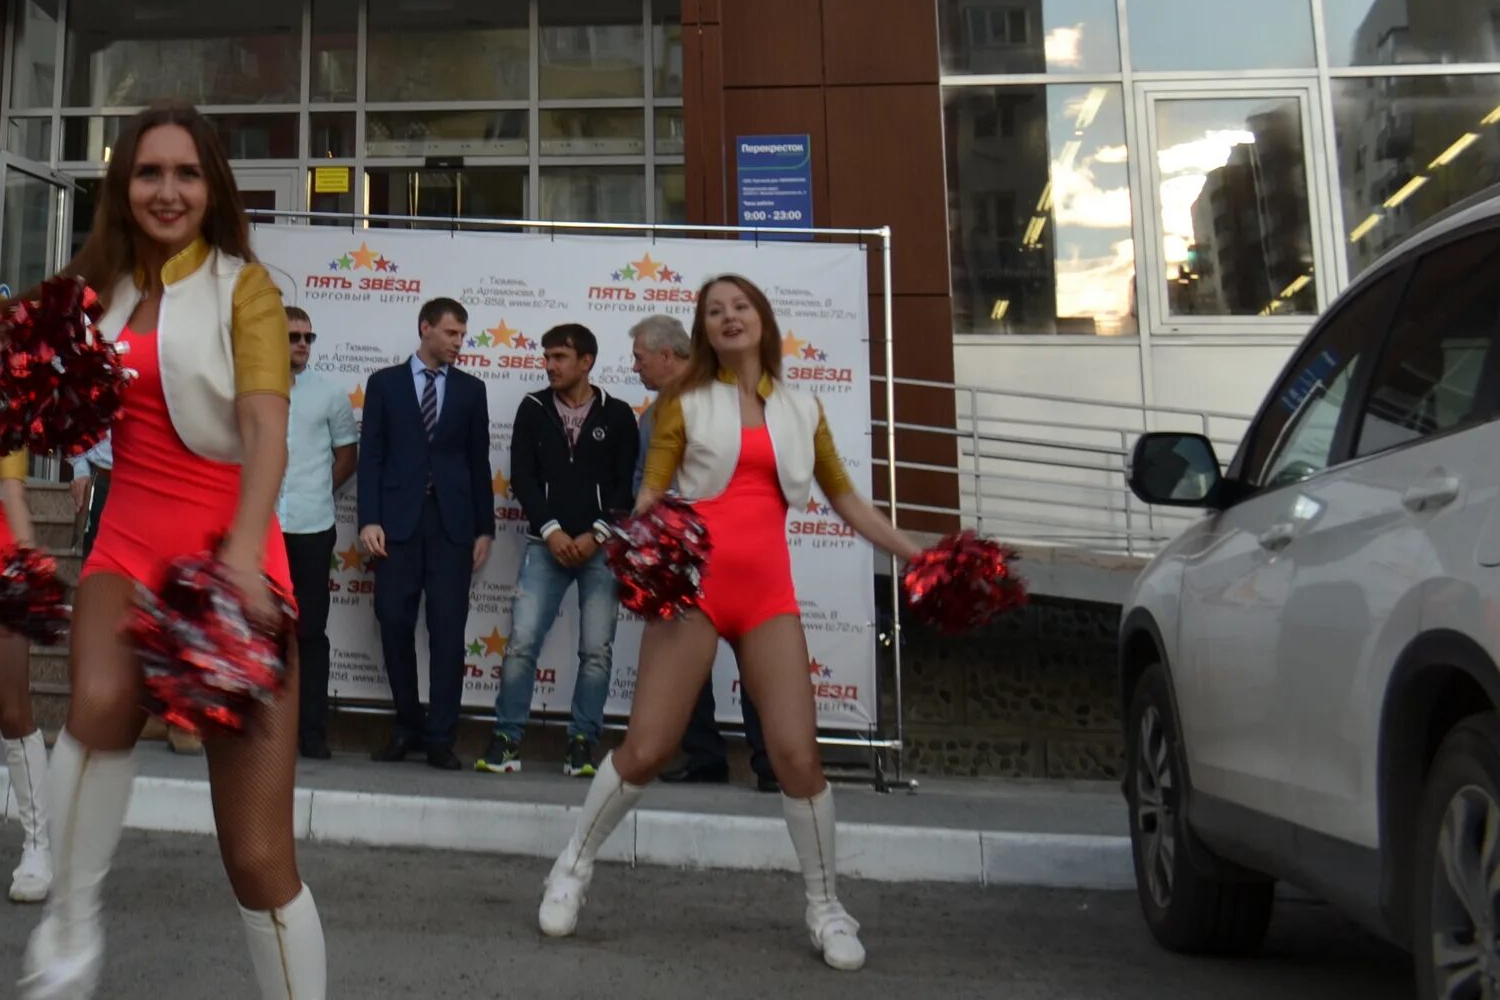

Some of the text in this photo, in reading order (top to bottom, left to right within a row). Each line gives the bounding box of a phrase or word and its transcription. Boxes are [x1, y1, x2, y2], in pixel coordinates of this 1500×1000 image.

[741, 143, 804, 154] Перекресток
[743, 210, 766, 221] 9:00
[773, 210, 802, 221] 23:00
[305, 275, 421, 293] ПЯТЬ ЗВЁЗД
[305, 291, 420, 304] ТОРГОВЫЙ ЦЕНТР
[588, 286, 637, 301] ПЯТЬ
[588, 302, 655, 313] ТОРГОВЫЙ
[497, 353, 548, 370] ЗВЁЗ
[787, 364, 852, 383] ЗВЁЗД
[810, 382, 852, 394] ЦЕНТР
[788, 519, 856, 538] ЗВЁЗД
[812, 538, 855, 549] ЦЕНТР
